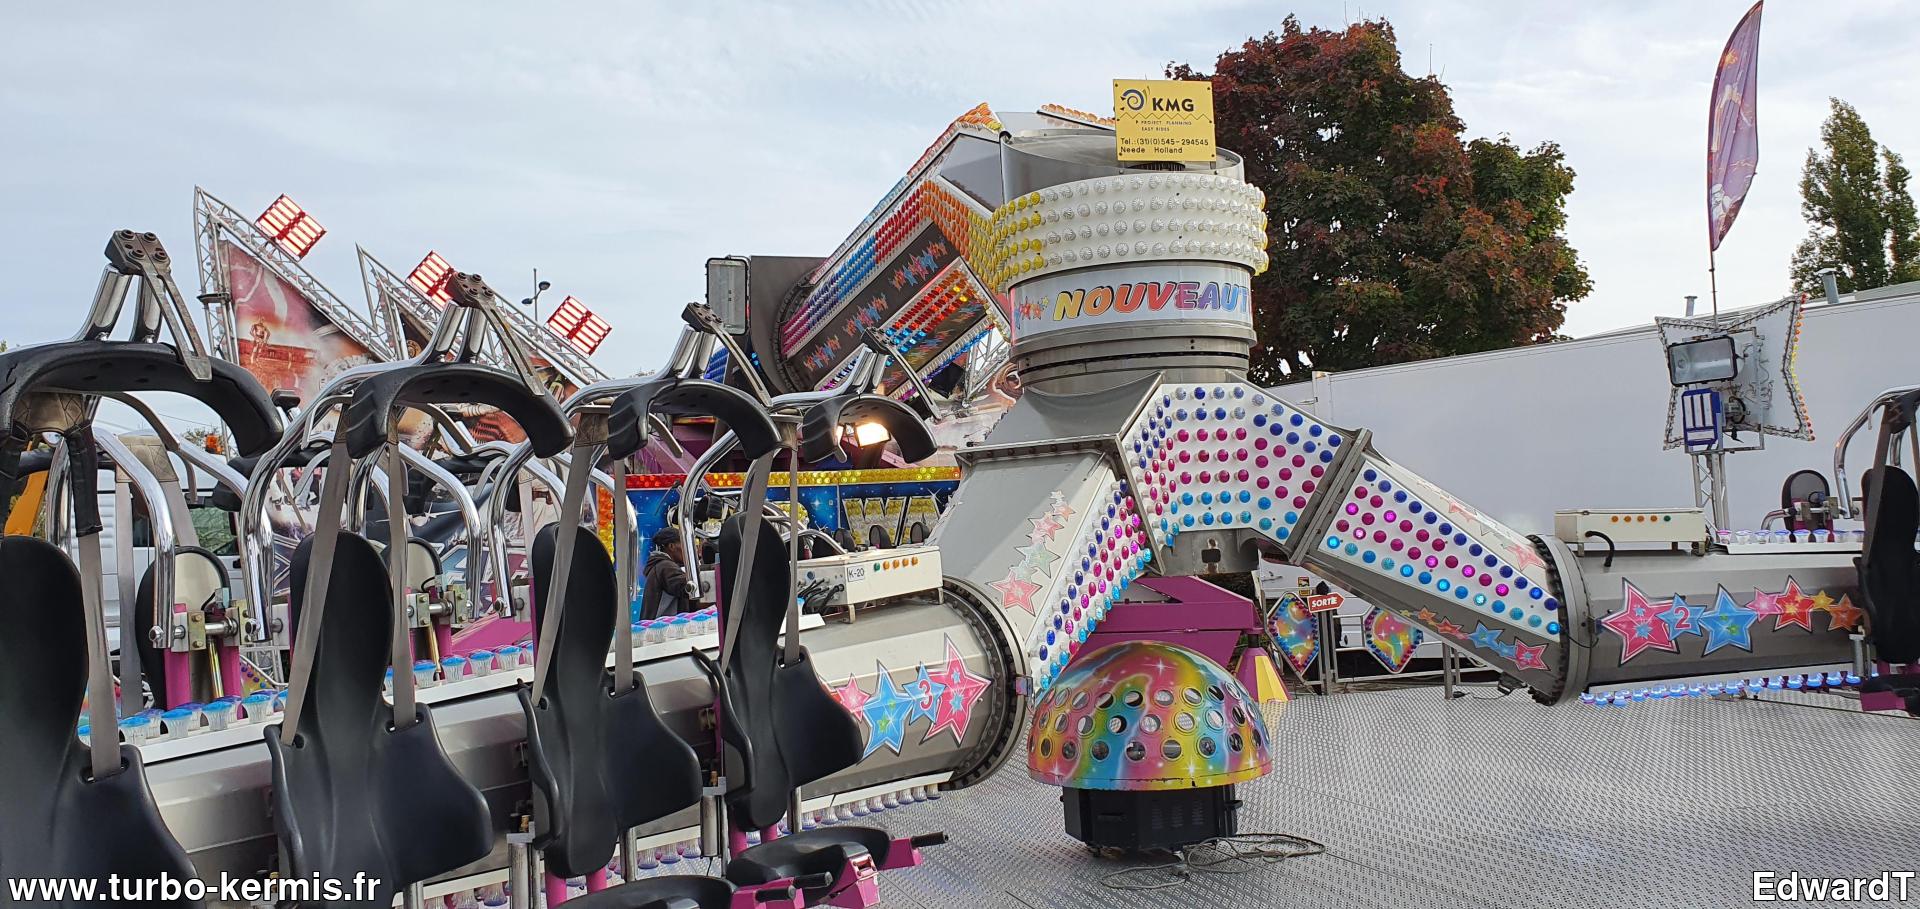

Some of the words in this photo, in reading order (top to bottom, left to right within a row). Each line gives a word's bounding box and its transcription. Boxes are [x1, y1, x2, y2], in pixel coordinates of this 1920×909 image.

[1152, 97, 1194, 112] KMG
[1120, 146, 1146, 154] Neede
[1674, 606, 1691, 629] 2
[918, 679, 933, 710] 3
